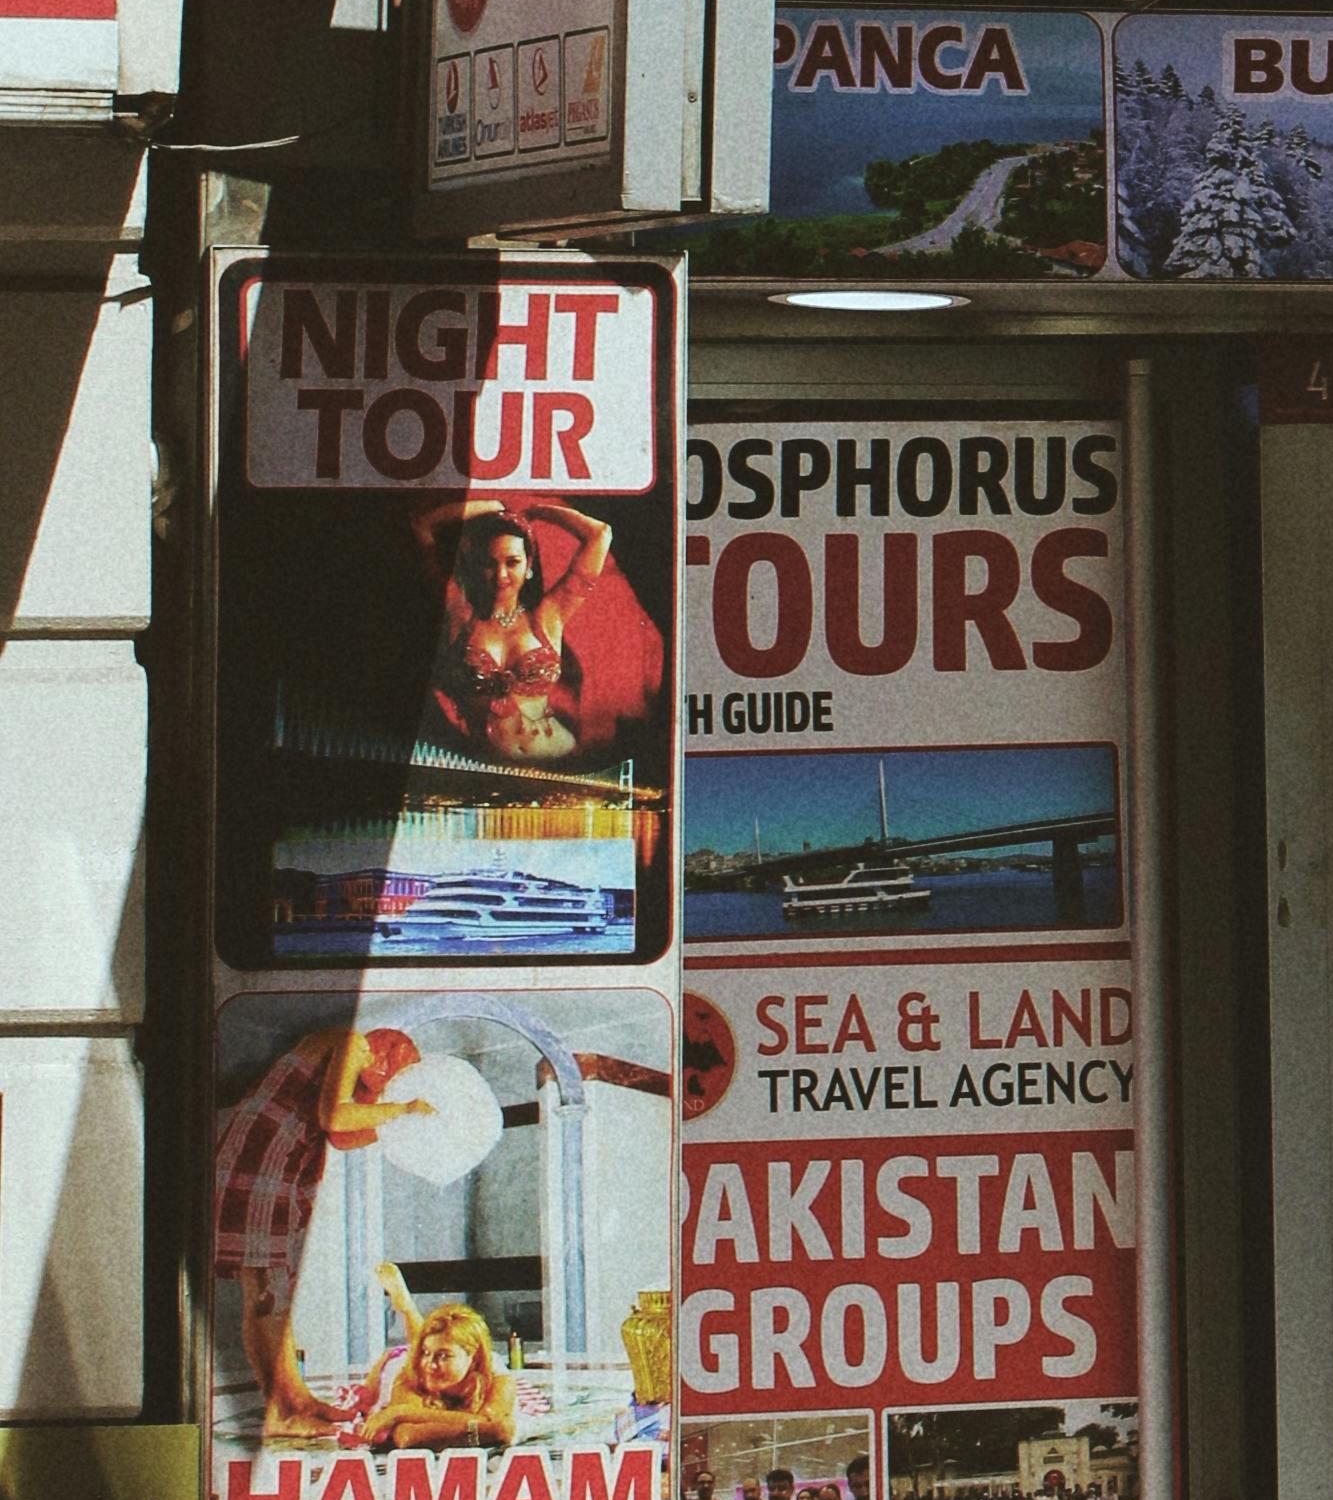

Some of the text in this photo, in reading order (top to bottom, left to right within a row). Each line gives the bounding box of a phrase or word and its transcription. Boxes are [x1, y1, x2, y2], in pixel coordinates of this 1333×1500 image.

[279, 289, 619, 384] NIGHT
[296, 389, 596, 482] TOUR
[723, 692, 834, 734] GUIDE
[756, 988, 1133, 1056] SEA & LAND
[758, 1066, 939, 1113] TRAVEL
[682, 1151, 1136, 1265] AKISTAN
[681, 1275, 1098, 1394] GROUPS
